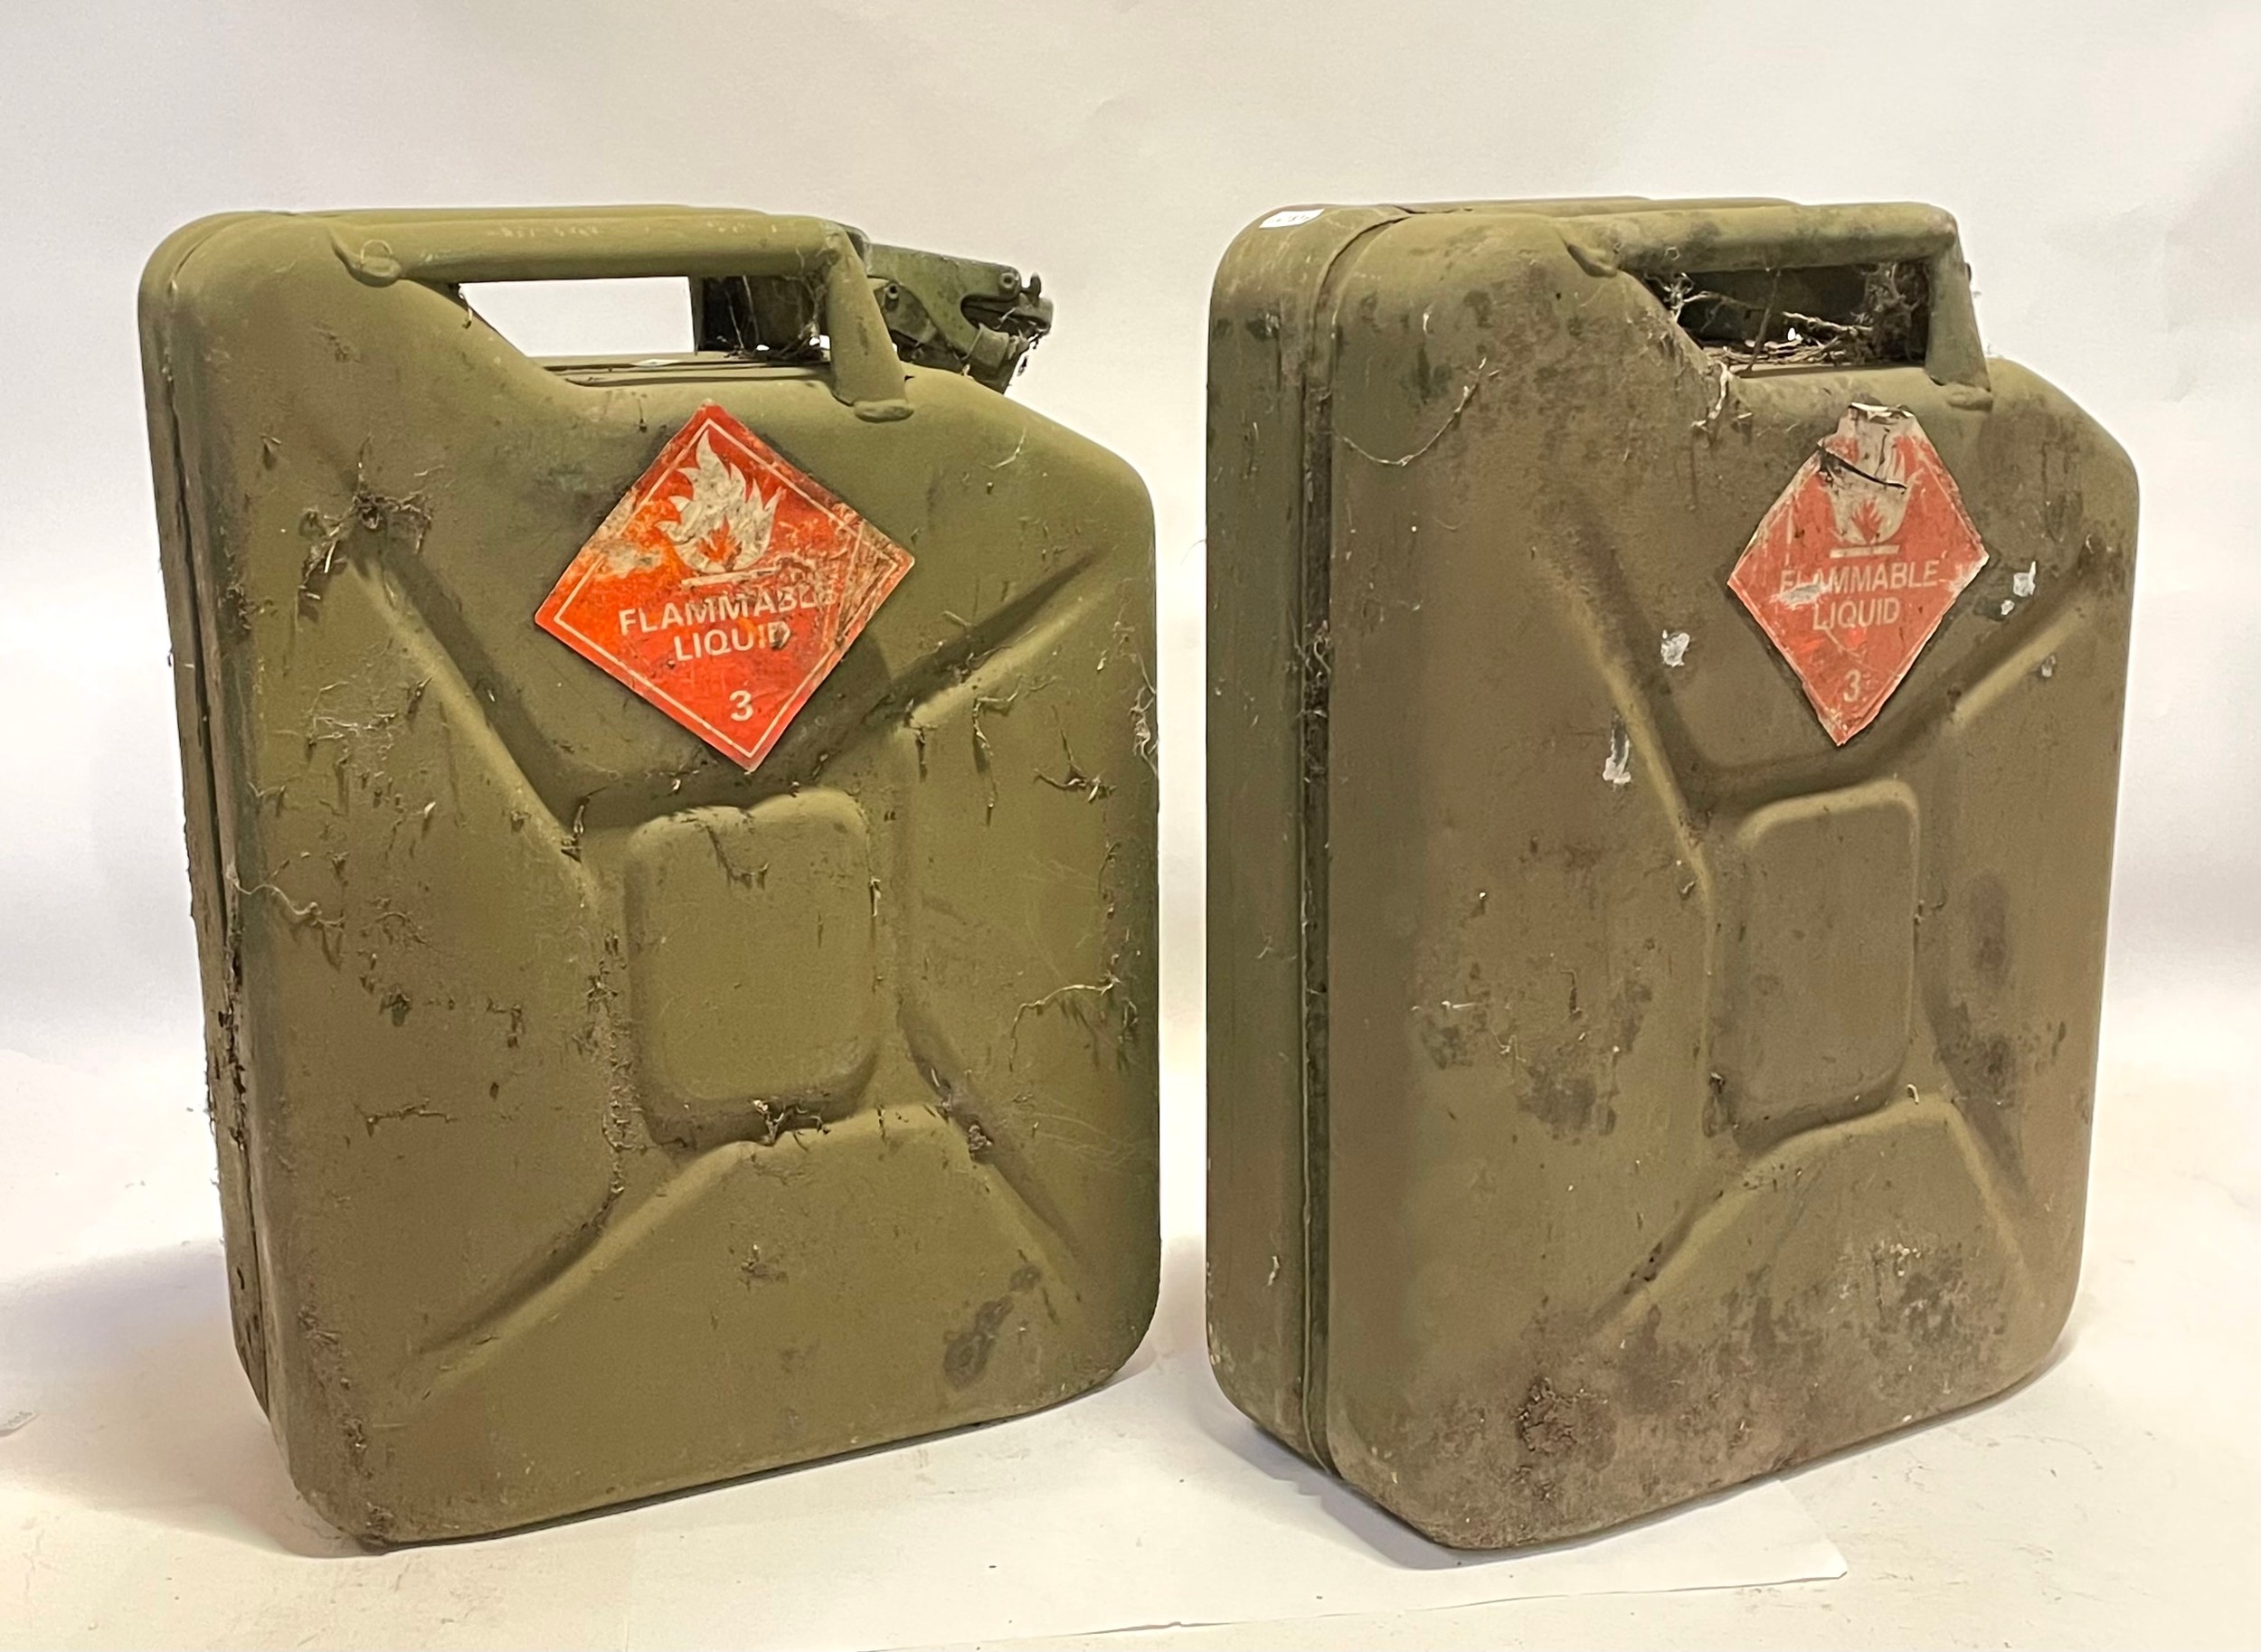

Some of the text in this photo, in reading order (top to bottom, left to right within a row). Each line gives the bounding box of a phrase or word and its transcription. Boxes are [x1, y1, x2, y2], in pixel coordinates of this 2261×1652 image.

[619, 580, 834, 636] FLAMMABL
[1812, 597, 1900, 630] LIQUID
[674, 621, 790, 661] LIQUID
[1843, 668, 1862, 703] 3
[729, 690, 753, 722] 3
